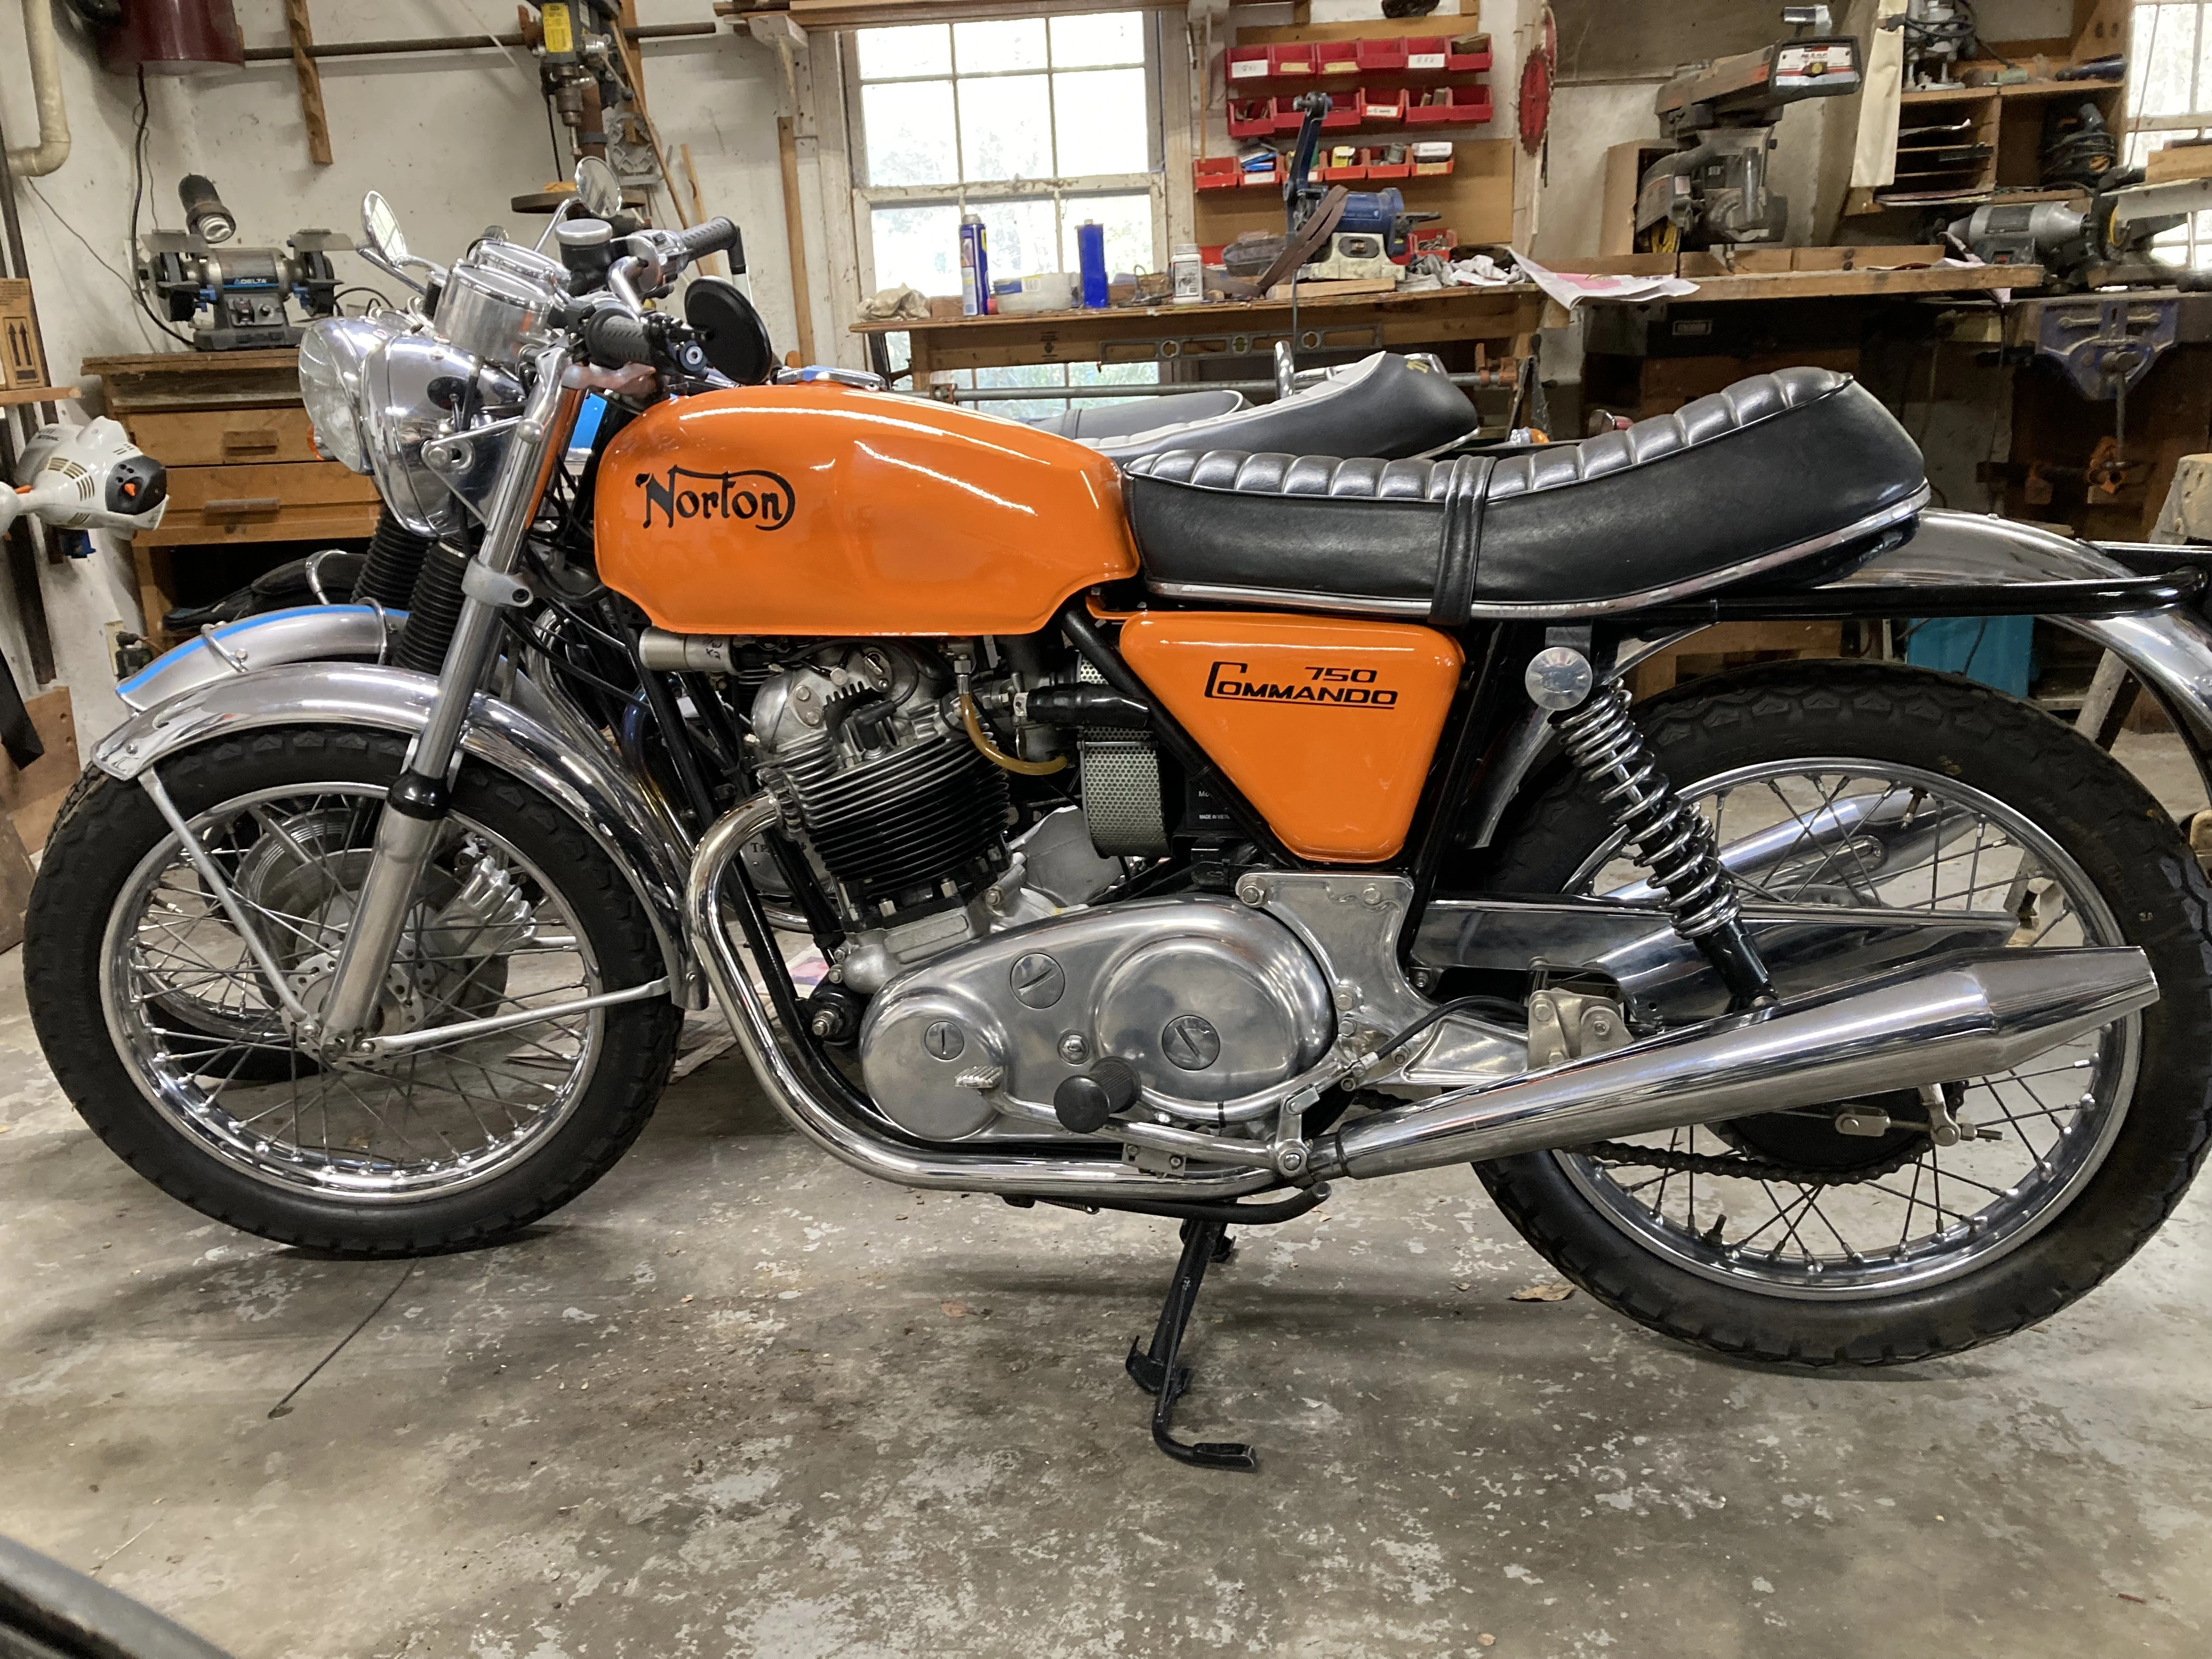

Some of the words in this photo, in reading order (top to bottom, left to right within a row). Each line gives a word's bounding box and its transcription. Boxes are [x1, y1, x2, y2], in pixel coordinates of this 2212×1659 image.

[635, 465, 795, 531] Norton
[1204, 661, 1398, 709] COMMANDO
[1305, 667, 1377, 683] 750
